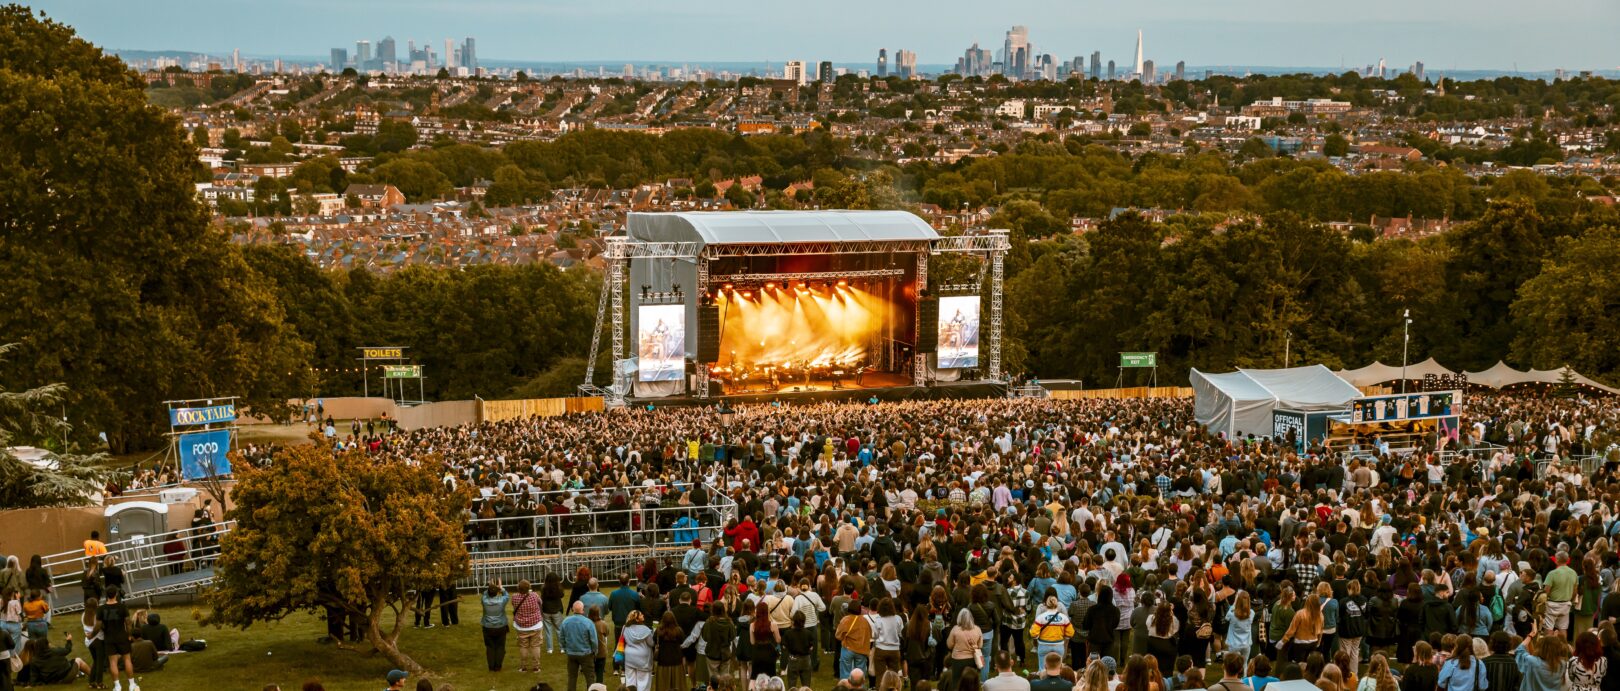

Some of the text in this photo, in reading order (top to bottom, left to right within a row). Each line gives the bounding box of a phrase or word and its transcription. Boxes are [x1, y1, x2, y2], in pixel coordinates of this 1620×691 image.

[364, 349, 401, 357] TOILETS
[1425, 373, 1467, 389] BAR
[177, 405, 235, 424] COCKTAILS
[1274, 414, 1302, 426] OFFICIAL
[192, 442, 218, 455] FOOD
